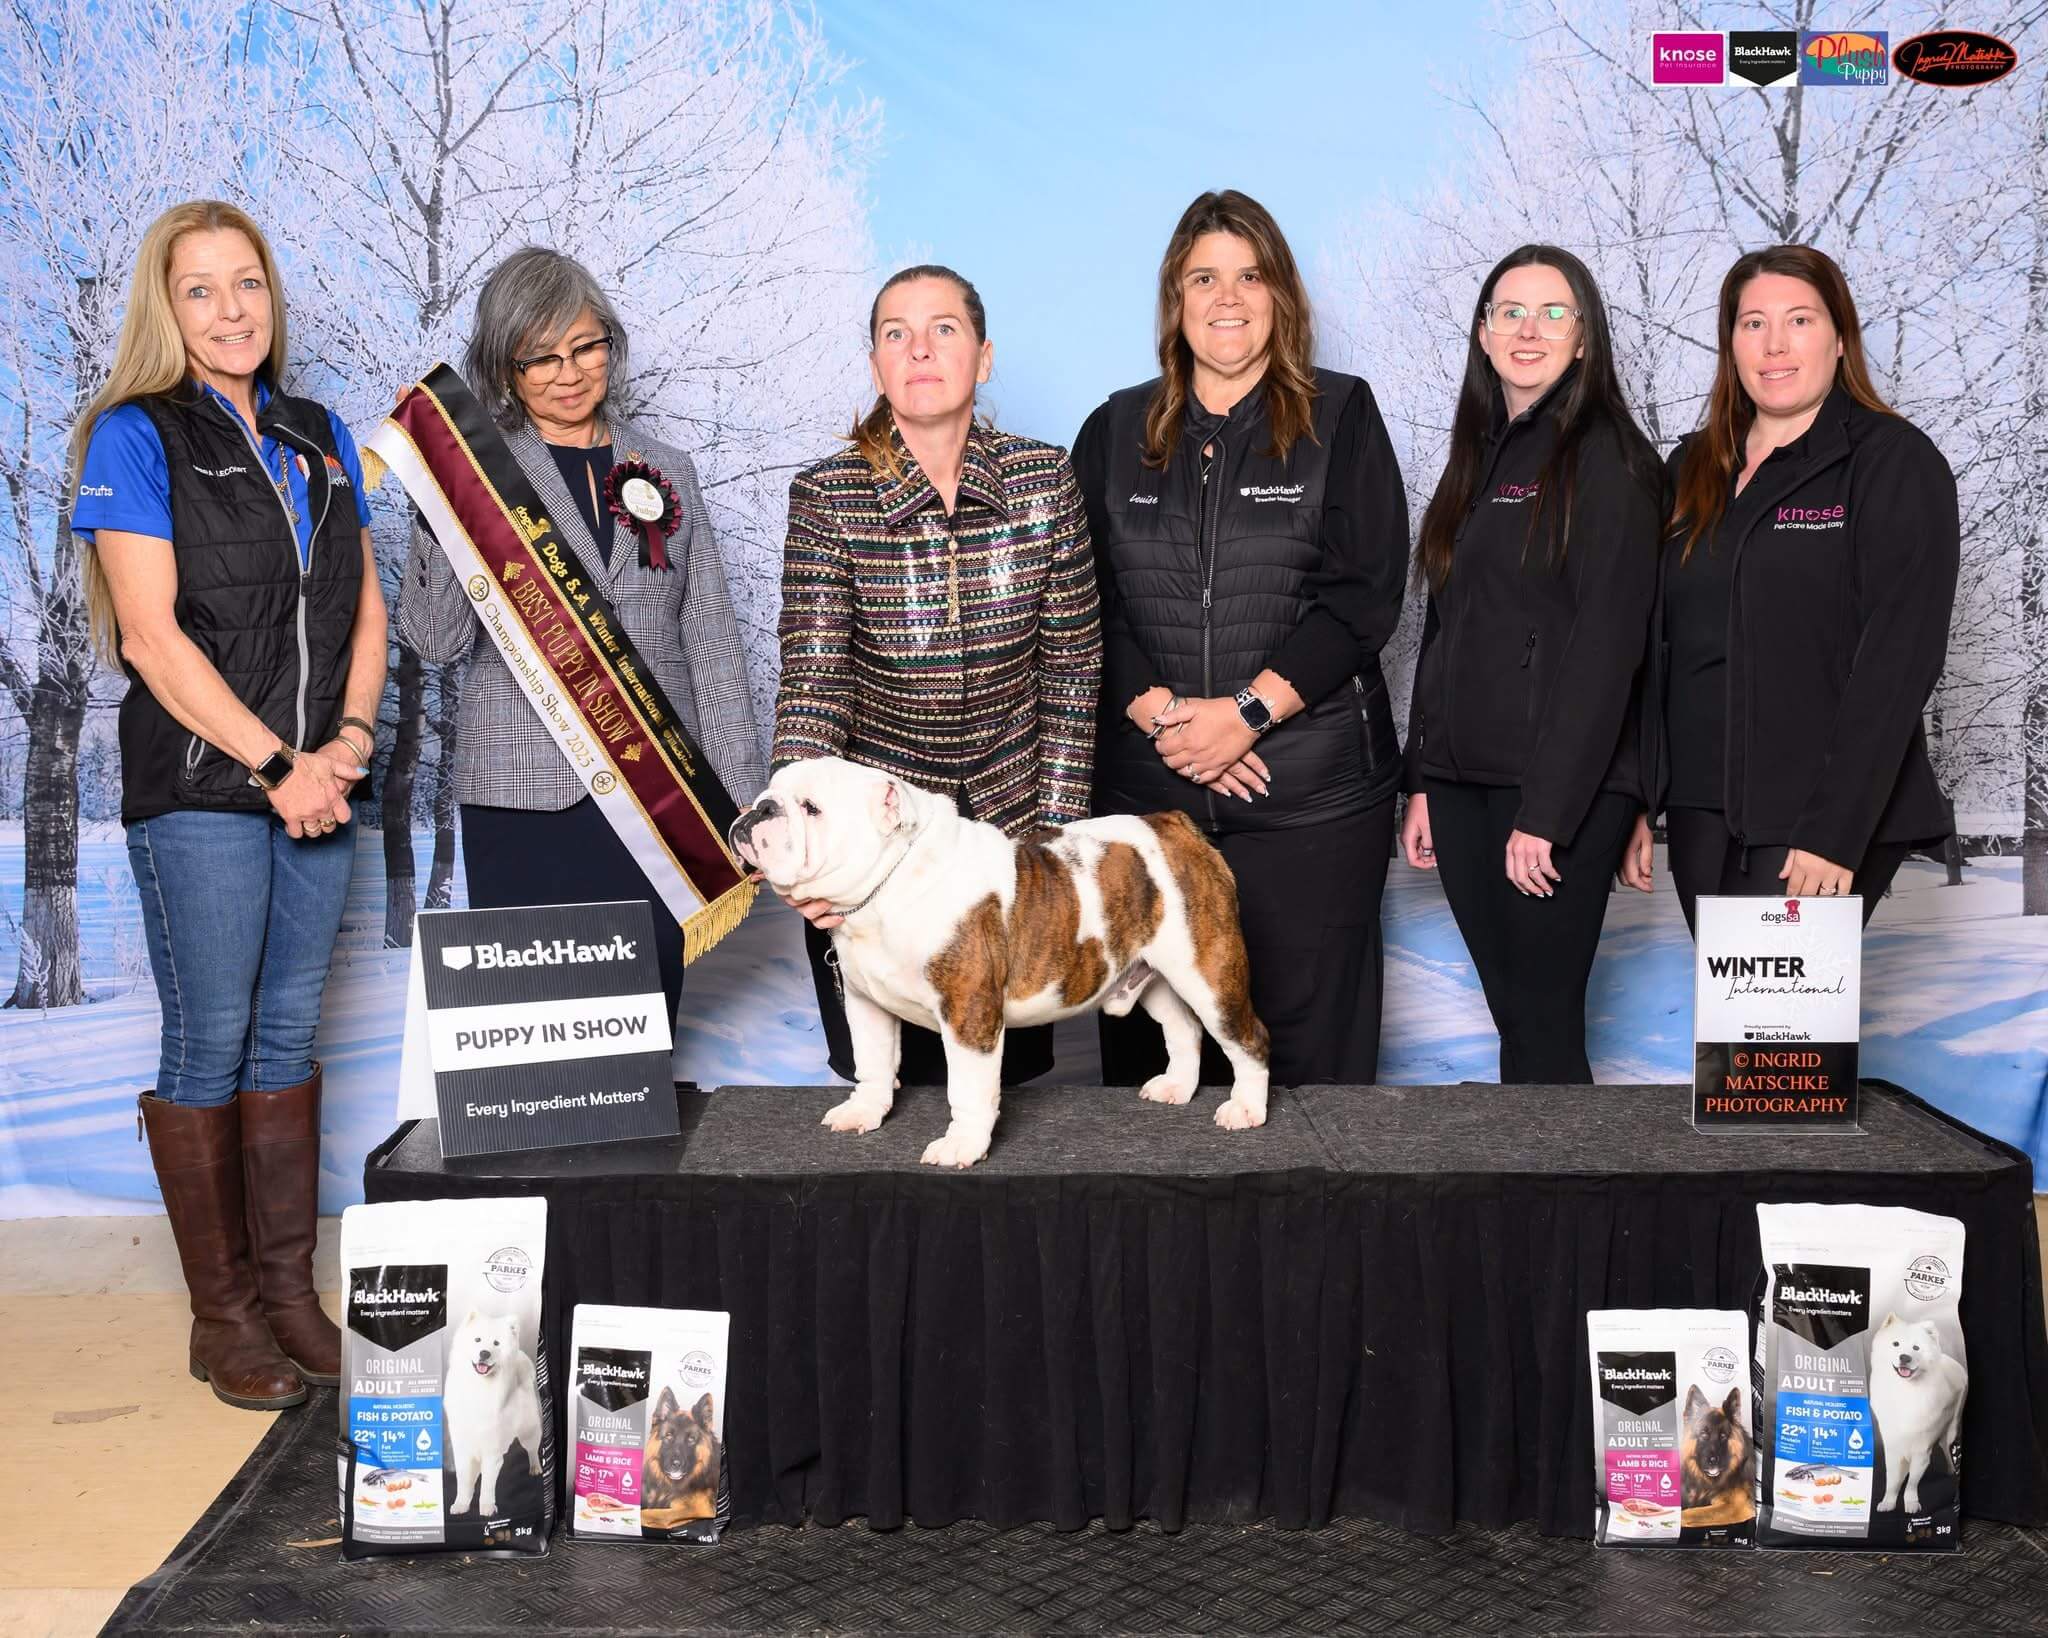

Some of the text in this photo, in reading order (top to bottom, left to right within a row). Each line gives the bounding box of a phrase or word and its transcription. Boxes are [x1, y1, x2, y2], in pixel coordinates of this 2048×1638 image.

[80, 485, 113, 497] Crufts
[1251, 485, 1304, 496] BlackHawk
[1129, 493, 1159, 505] Louise
[1777, 505, 1845, 521] knose
[1827, 521, 1844, 529] Easy
[541, 541, 568, 578] Dogs
[588, 607, 620, 653] Winter
[616, 655, 665, 727] International
[511, 577, 634, 743] BEST PUPPY IN SHOW
[484, 603, 595, 767] Championship Show 2025
[476, 935, 636, 969] BlackHawk
[1707, 957, 1806, 978] WINTER
[1725, 976, 1846, 1000] International
[456, 1016, 647, 1051] PUPPY IN SHOW
[1755, 1032, 1811, 1041] BlackHawk
[466, 1101, 508, 1118] Every
[511, 1096, 587, 1116] Ingredient
[490, 1264, 528, 1275] PARKES
[1910, 1271, 1946, 1285] PARKES
[354, 1288, 440, 1304] BlackHawk
[1780, 1286, 1862, 1304] BlackHawk
[361, 1309, 375, 1318] Every
[375, 1309, 405, 1317] ingredient
[1788, 1305, 1806, 1315] Every
[366, 1358, 424, 1374] ORIGINAL
[583, 1363, 645, 1379] BlackHawk
[683, 1364, 711, 1375] PARKES
[1795, 1354, 1852, 1374] ORIGINAL
[1605, 1368, 1671, 1380] BlackHawk
[354, 1380, 403, 1395] ADULT
[1781, 1375, 1835, 1392] ADULT
[357, 1411, 433, 1422] FISH & POTATO
[1786, 1406, 1862, 1421] FISH & POTATO
[588, 1416, 632, 1430] ORIGINAL
[1618, 1420, 1663, 1433] ORIGINAL
[1781, 1423, 1807, 1437] 22%
[354, 1429, 376, 1442] 22%
[381, 1430, 406, 1443] 14%
[579, 1430, 616, 1444] ADULT
[1812, 1427, 1838, 1440] 14%
[1608, 1436, 1648, 1447] ADULT
[585, 1453, 604, 1463] LAMB
[613, 1457, 632, 1466] RICE
[1936, 1526, 1951, 1535] 3kg
